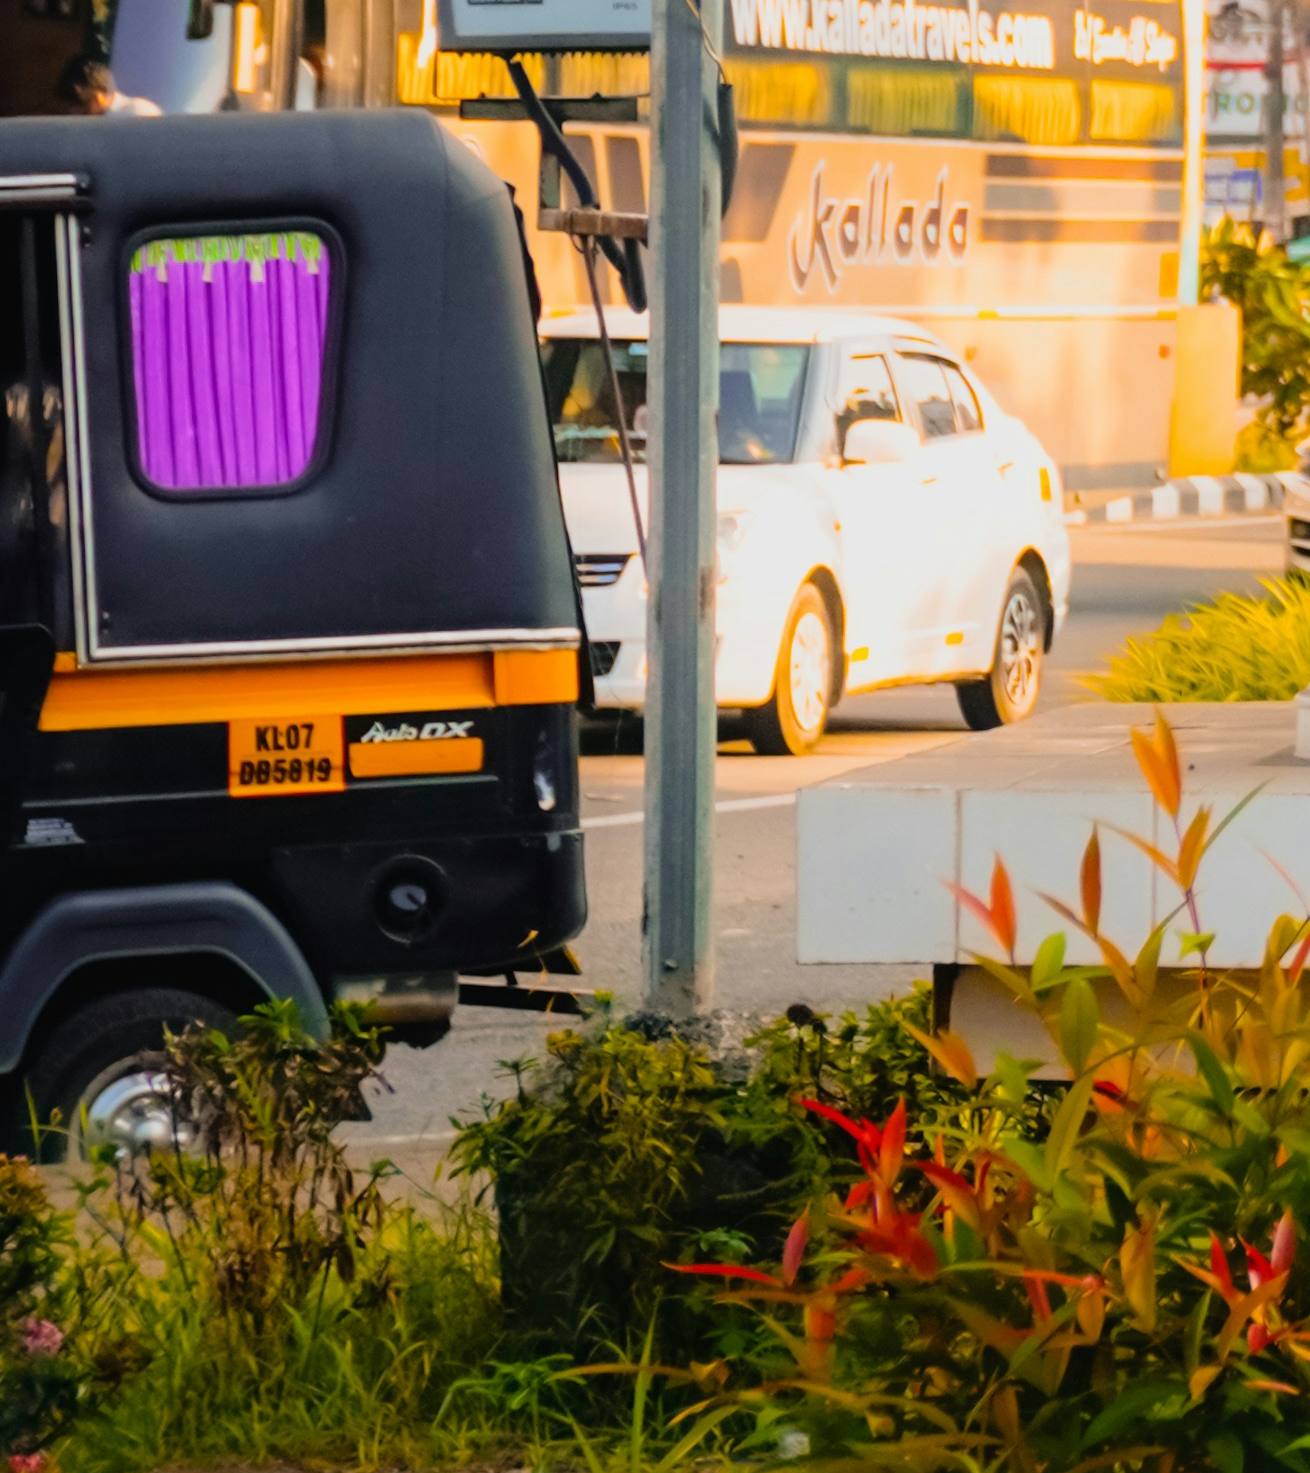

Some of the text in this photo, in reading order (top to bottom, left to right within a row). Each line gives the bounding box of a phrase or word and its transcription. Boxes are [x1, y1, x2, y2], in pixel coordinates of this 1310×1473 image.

[256, 723, 314, 751] KL07
[360, 721, 418, 743] Auto
[239, 757, 332, 785] DB5819
